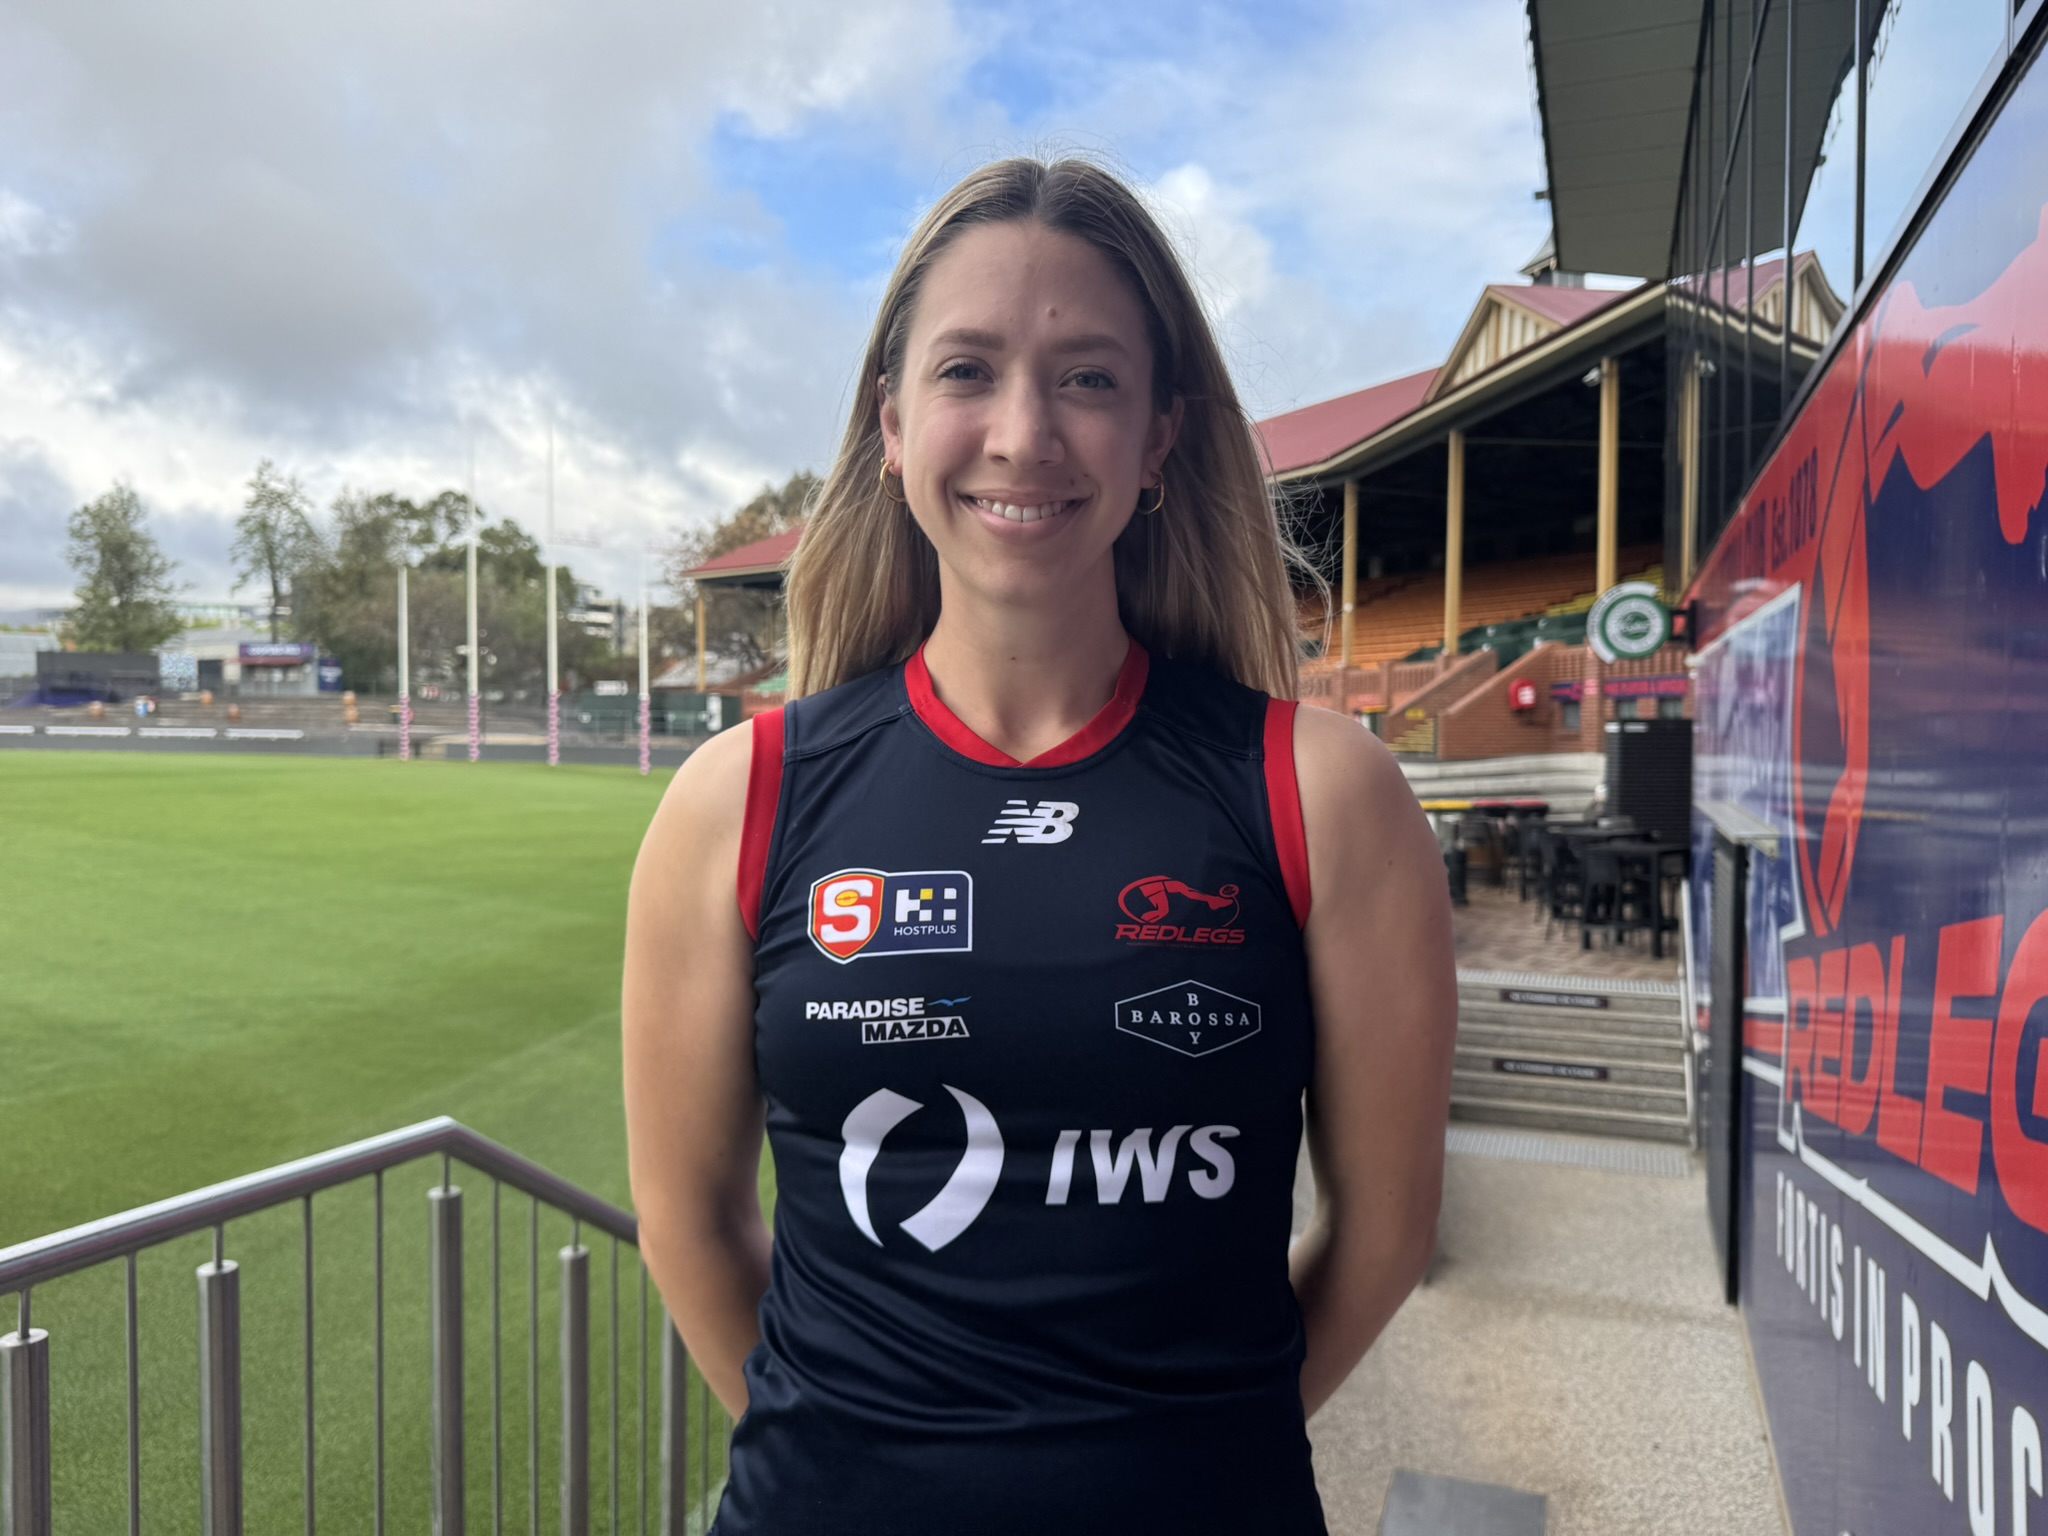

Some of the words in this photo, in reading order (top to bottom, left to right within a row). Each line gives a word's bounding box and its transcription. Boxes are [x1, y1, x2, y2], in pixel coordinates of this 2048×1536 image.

[981, 800, 1080, 844] NB
[894, 924, 957, 936] HOSTPLUS
[1114, 923, 1246, 945] REDLEGS
[805, 997, 925, 1020] PARADISE
[1131, 1009, 1250, 1026] BAROSSA
[863, 1018, 967, 1043] MAZDA
[1045, 1124, 1241, 1206] IWS
[1776, 1169, 1844, 1342] FORTIS
[1853, 1244, 1886, 1404] IN
